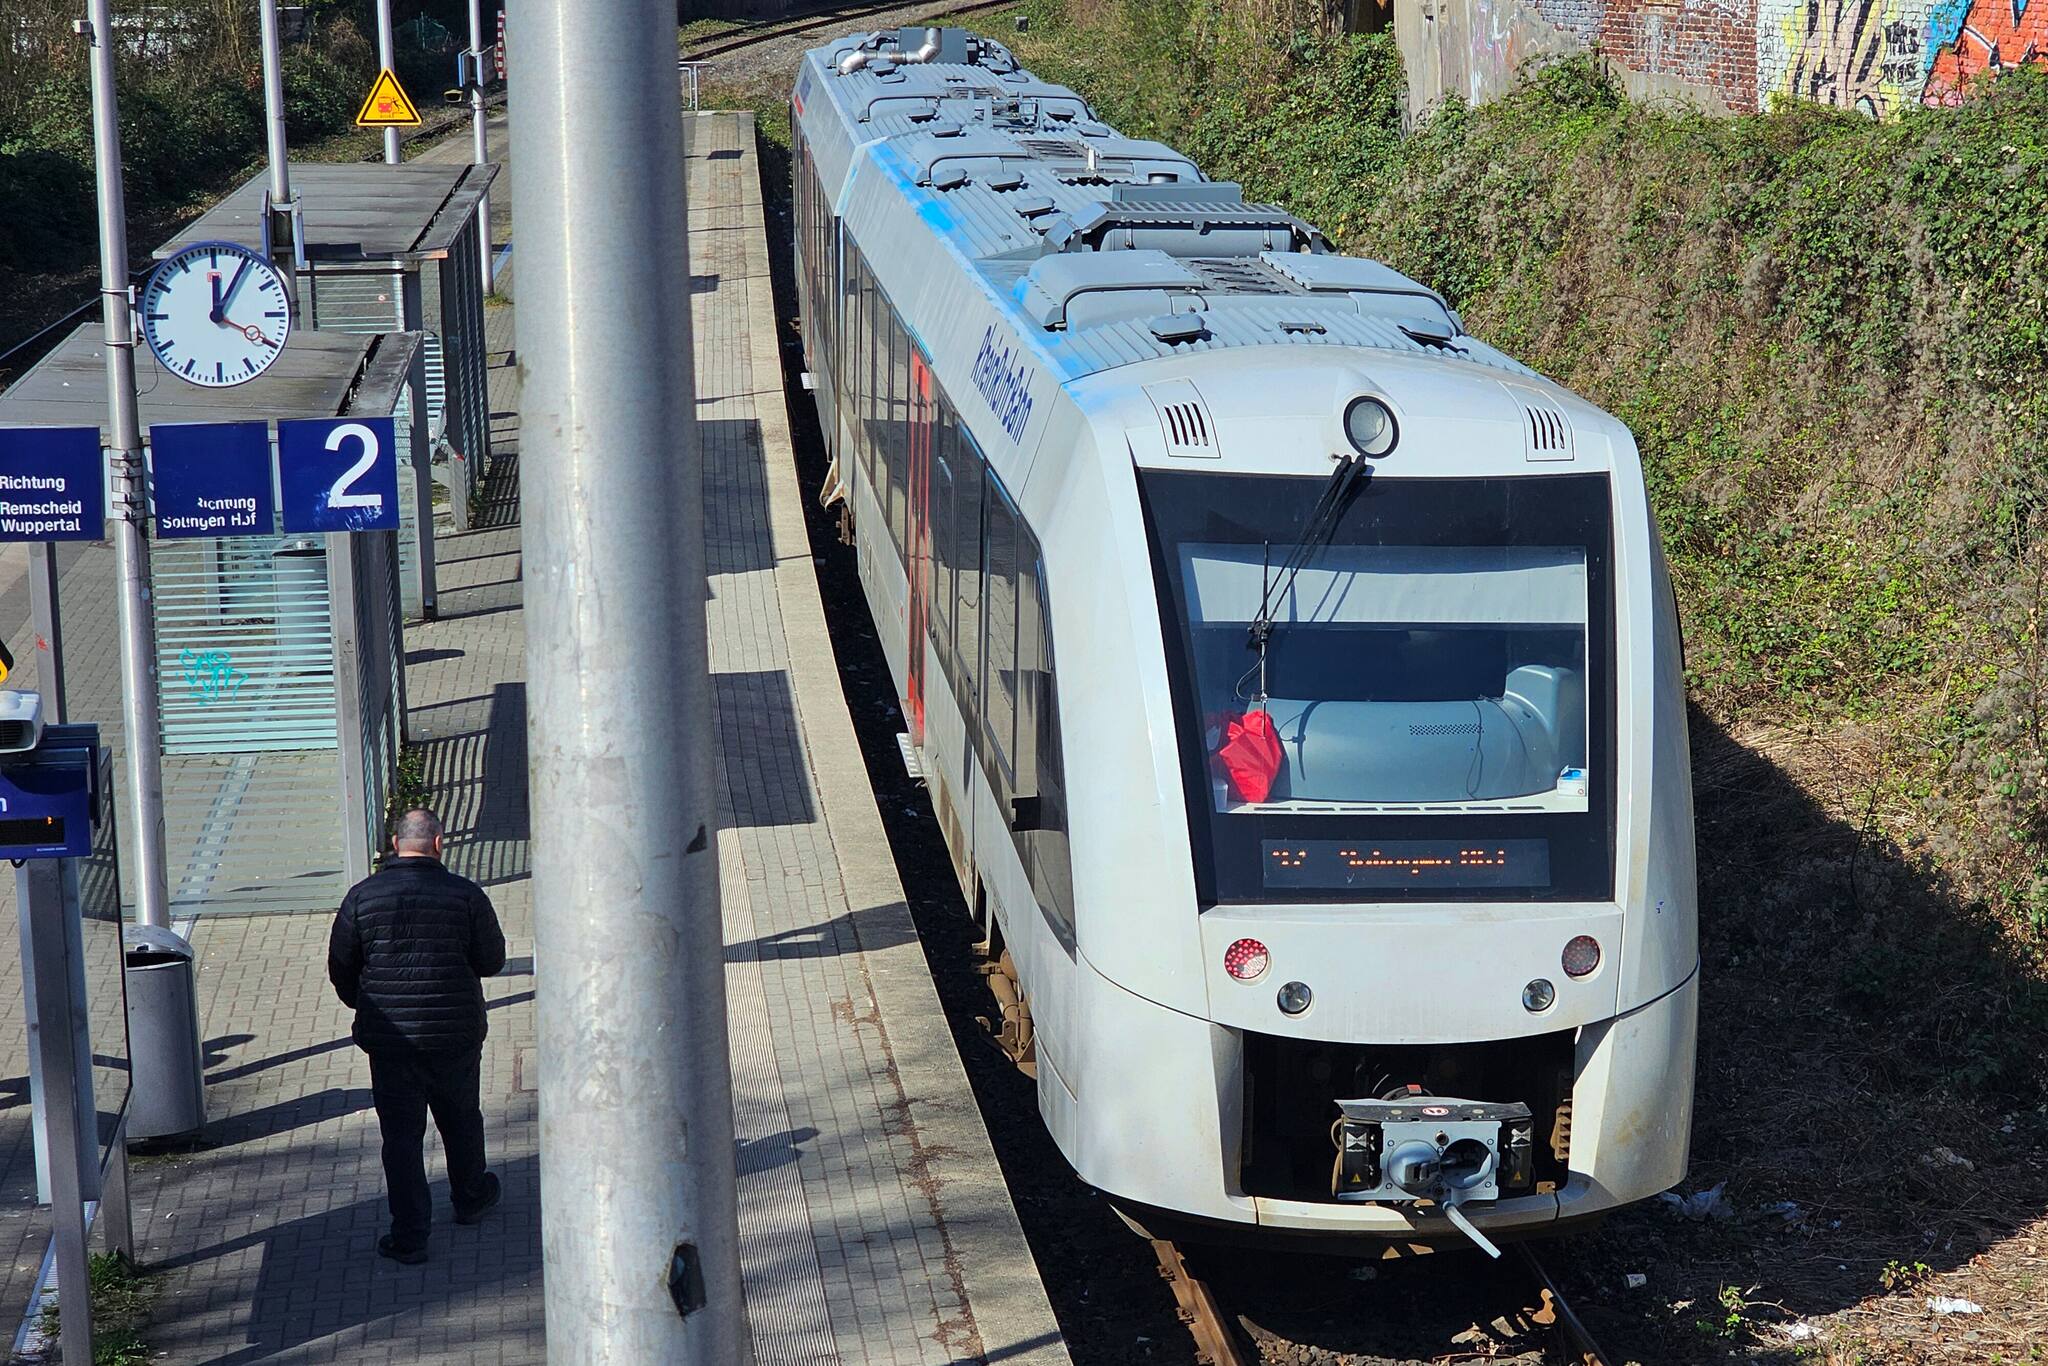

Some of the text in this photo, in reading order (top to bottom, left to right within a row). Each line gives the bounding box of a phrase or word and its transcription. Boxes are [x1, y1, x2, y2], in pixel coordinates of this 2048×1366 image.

[970, 322, 1035, 446] RheinRuhrBahn
[324, 423, 382, 508] 2
[0, 475, 66, 492] Richtung
[0, 500, 82, 515] Remscheid
[1, 517, 81, 535] Wuppertal
